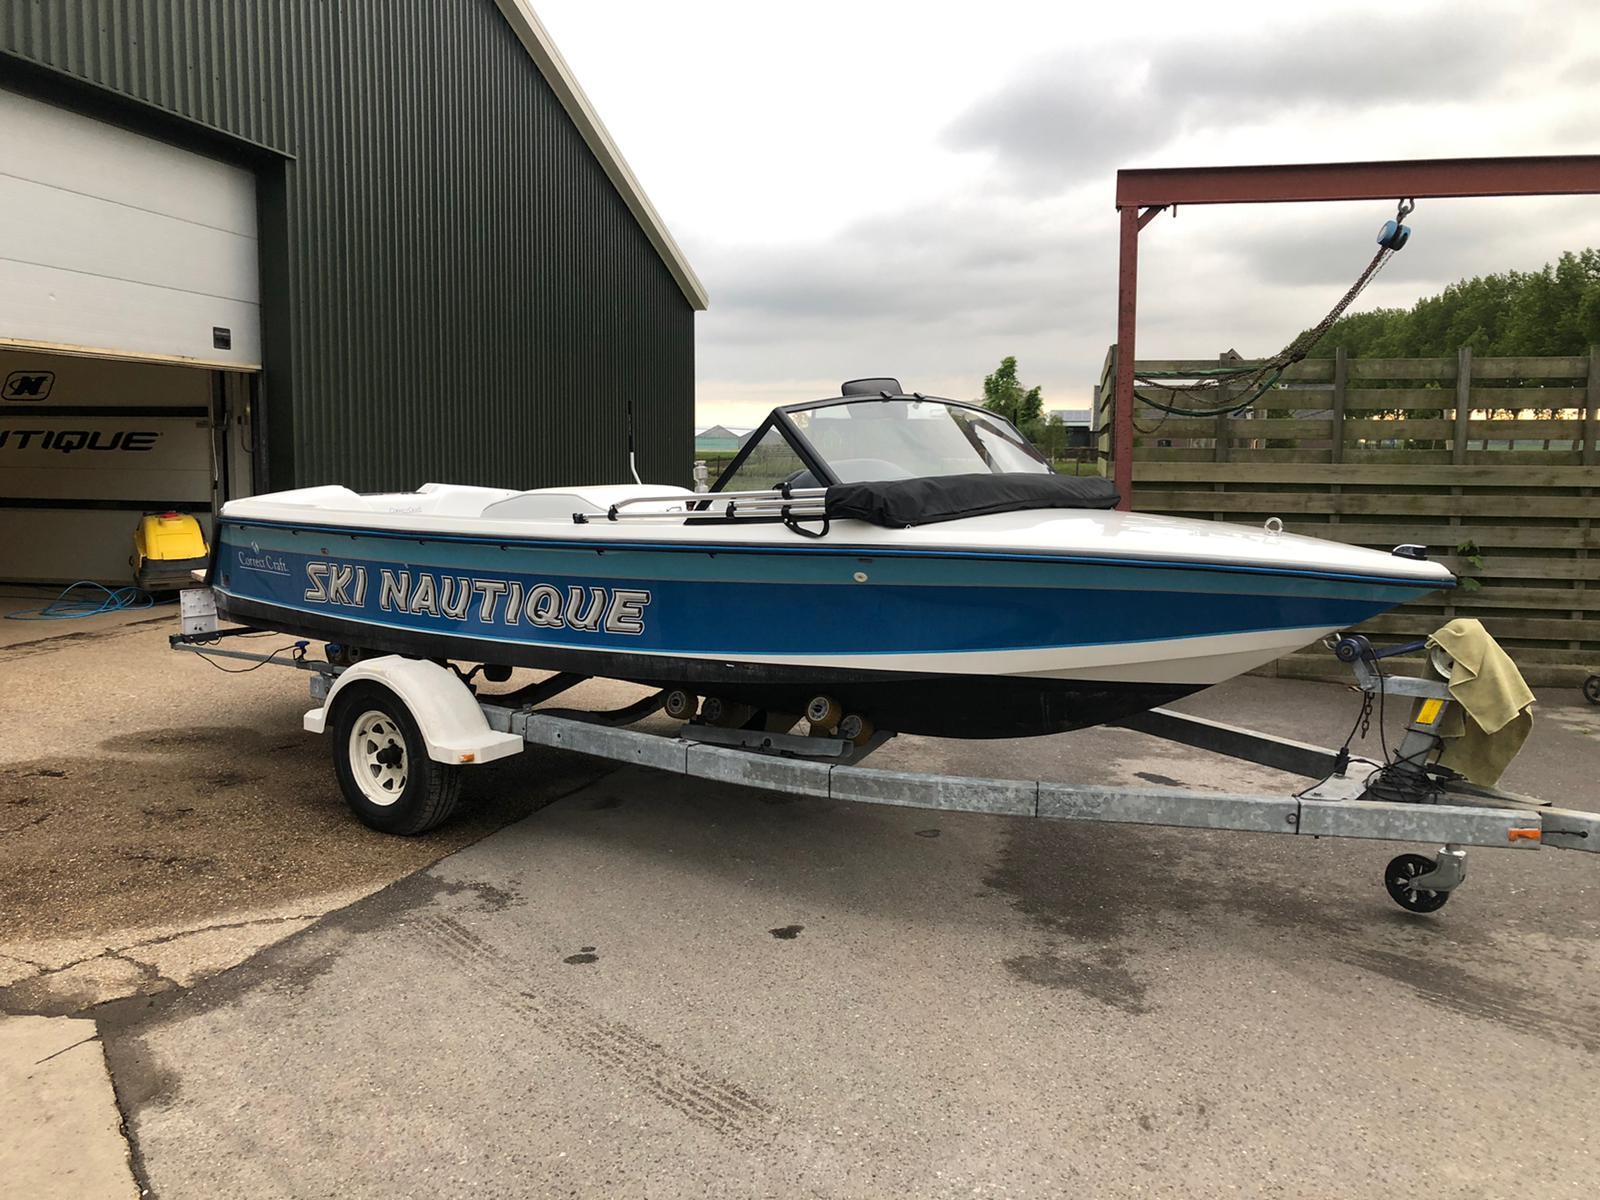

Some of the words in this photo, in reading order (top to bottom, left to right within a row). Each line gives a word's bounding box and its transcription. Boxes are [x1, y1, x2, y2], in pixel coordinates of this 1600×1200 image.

[238, 551, 265, 568] Correct
[266, 555, 288, 572] Craft
[304, 561, 368, 607] SKI
[380, 569, 651, 635] NAUTIQUE
